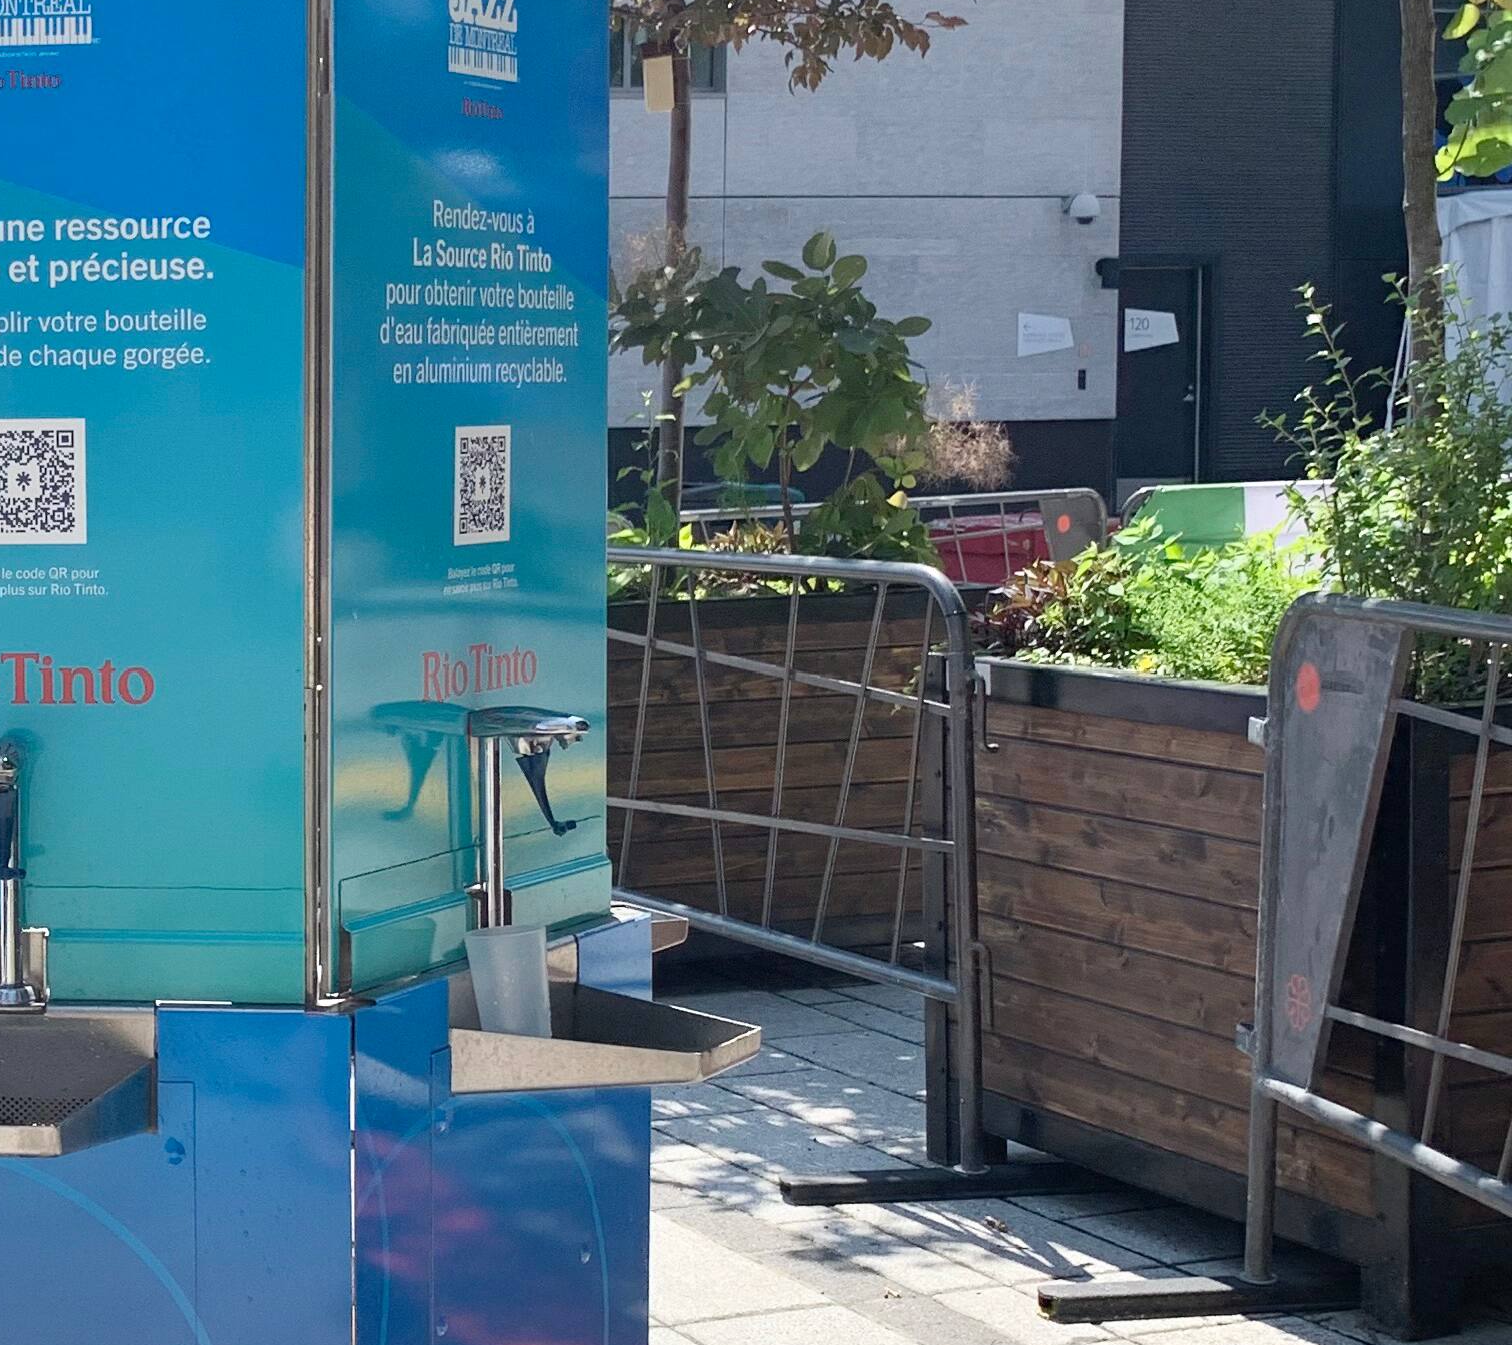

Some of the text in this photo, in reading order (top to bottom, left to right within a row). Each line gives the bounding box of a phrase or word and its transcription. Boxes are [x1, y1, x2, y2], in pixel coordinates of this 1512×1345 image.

[54, 214, 211, 242] ressource
[433, 199, 535, 234] Rendez-vous à
[8, 257, 39, 283] et
[49, 252, 214, 287] précieuse.
[413, 237, 552, 273] La Source Rio Tinto
[386, 279, 575, 310] pour obtenir votre bouteille
[37, 313, 97, 333] votre
[105, 309, 207, 333] bouteille
[380, 316, 579, 350] d'eau fabriquée entièrement
[1129, 317, 1150, 331] 120
[29, 344, 116, 371] chaque
[123, 343, 211, 372] gorgée.
[393, 357, 567, 389] en aluminium recyclable.
[2, 567, 13, 579] le
[15, 567, 46, 579] code
[48, 567, 68, 580] QR
[71, 568, 100, 582] pour
[0, 584, 25, 598] plus
[28, 585, 47, 596] sur
[50, 583, 71, 596] Rio
[73, 583, 109, 596] Tinto.
